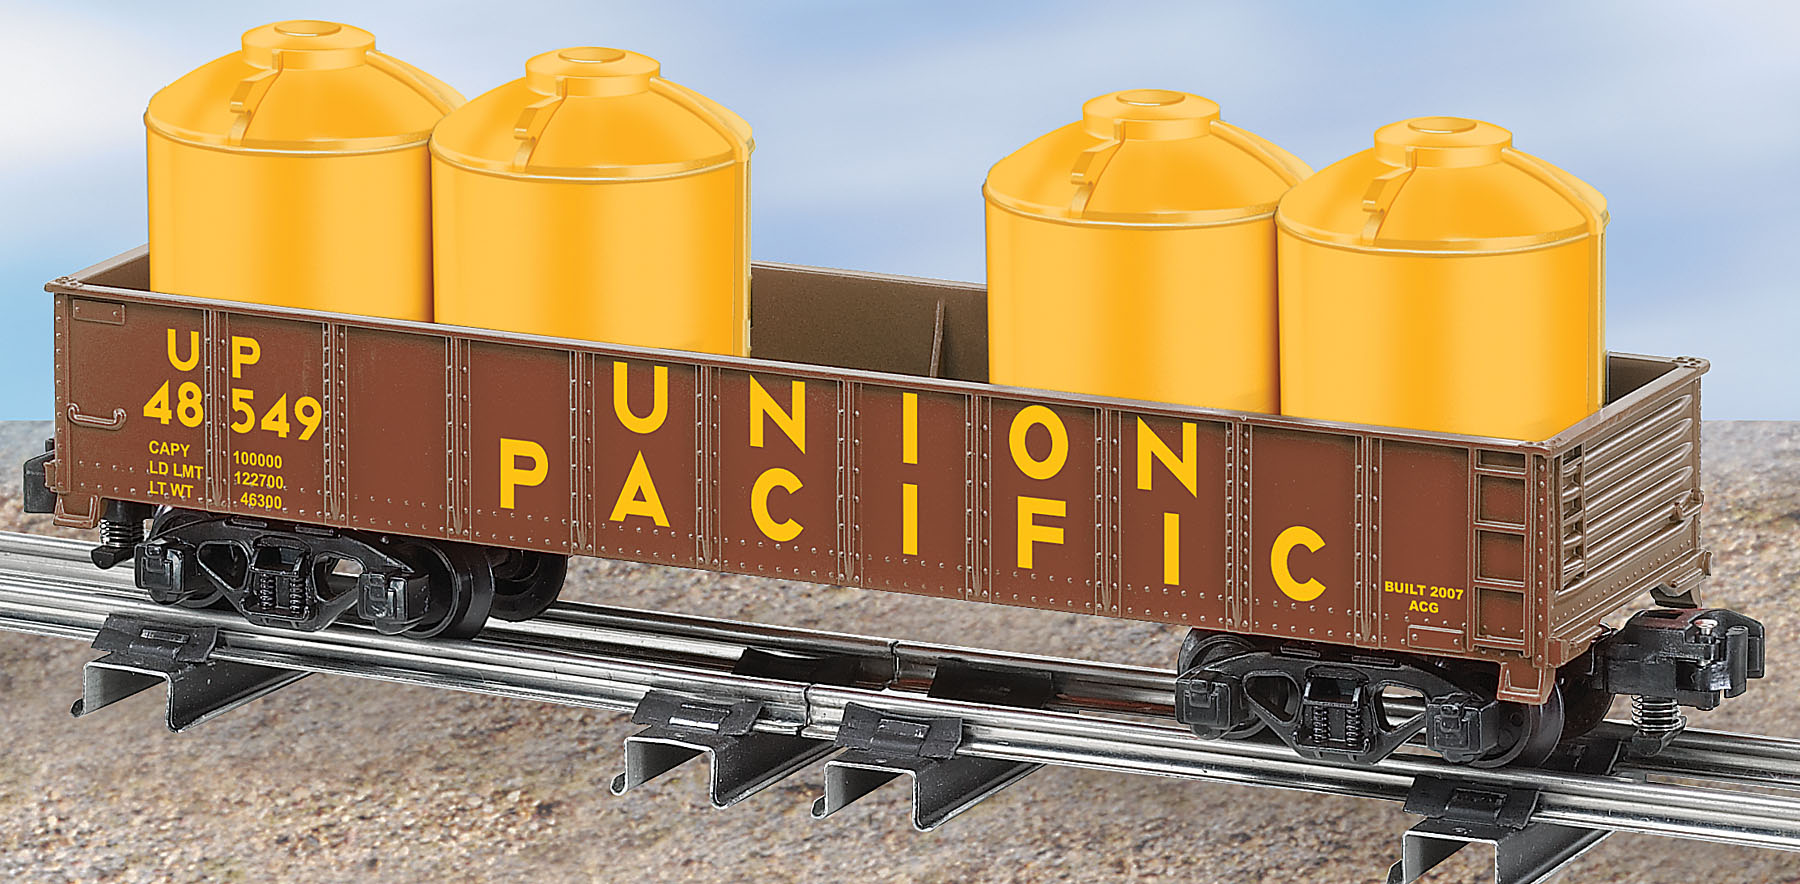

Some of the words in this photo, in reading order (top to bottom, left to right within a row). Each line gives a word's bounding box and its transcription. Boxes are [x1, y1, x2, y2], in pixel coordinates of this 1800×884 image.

[613, 361, 1198, 498] UNION
[149, 440, 190, 458] CAPY
[233, 450, 282, 469] 100000
[149, 460, 169, 476] LD
[173, 463, 204, 480] LMT
[234, 470, 284, 490] 122700
[149, 480, 167, 496] LT
[170, 483, 194, 499] WT
[240, 491, 283, 510] 46300
[499, 437, 1327, 602] PACIFIC
[1384, 580, 1427, 597] BUILT
[1429, 585, 1464, 601] 2007
[1408, 599, 1439, 614] ACG
